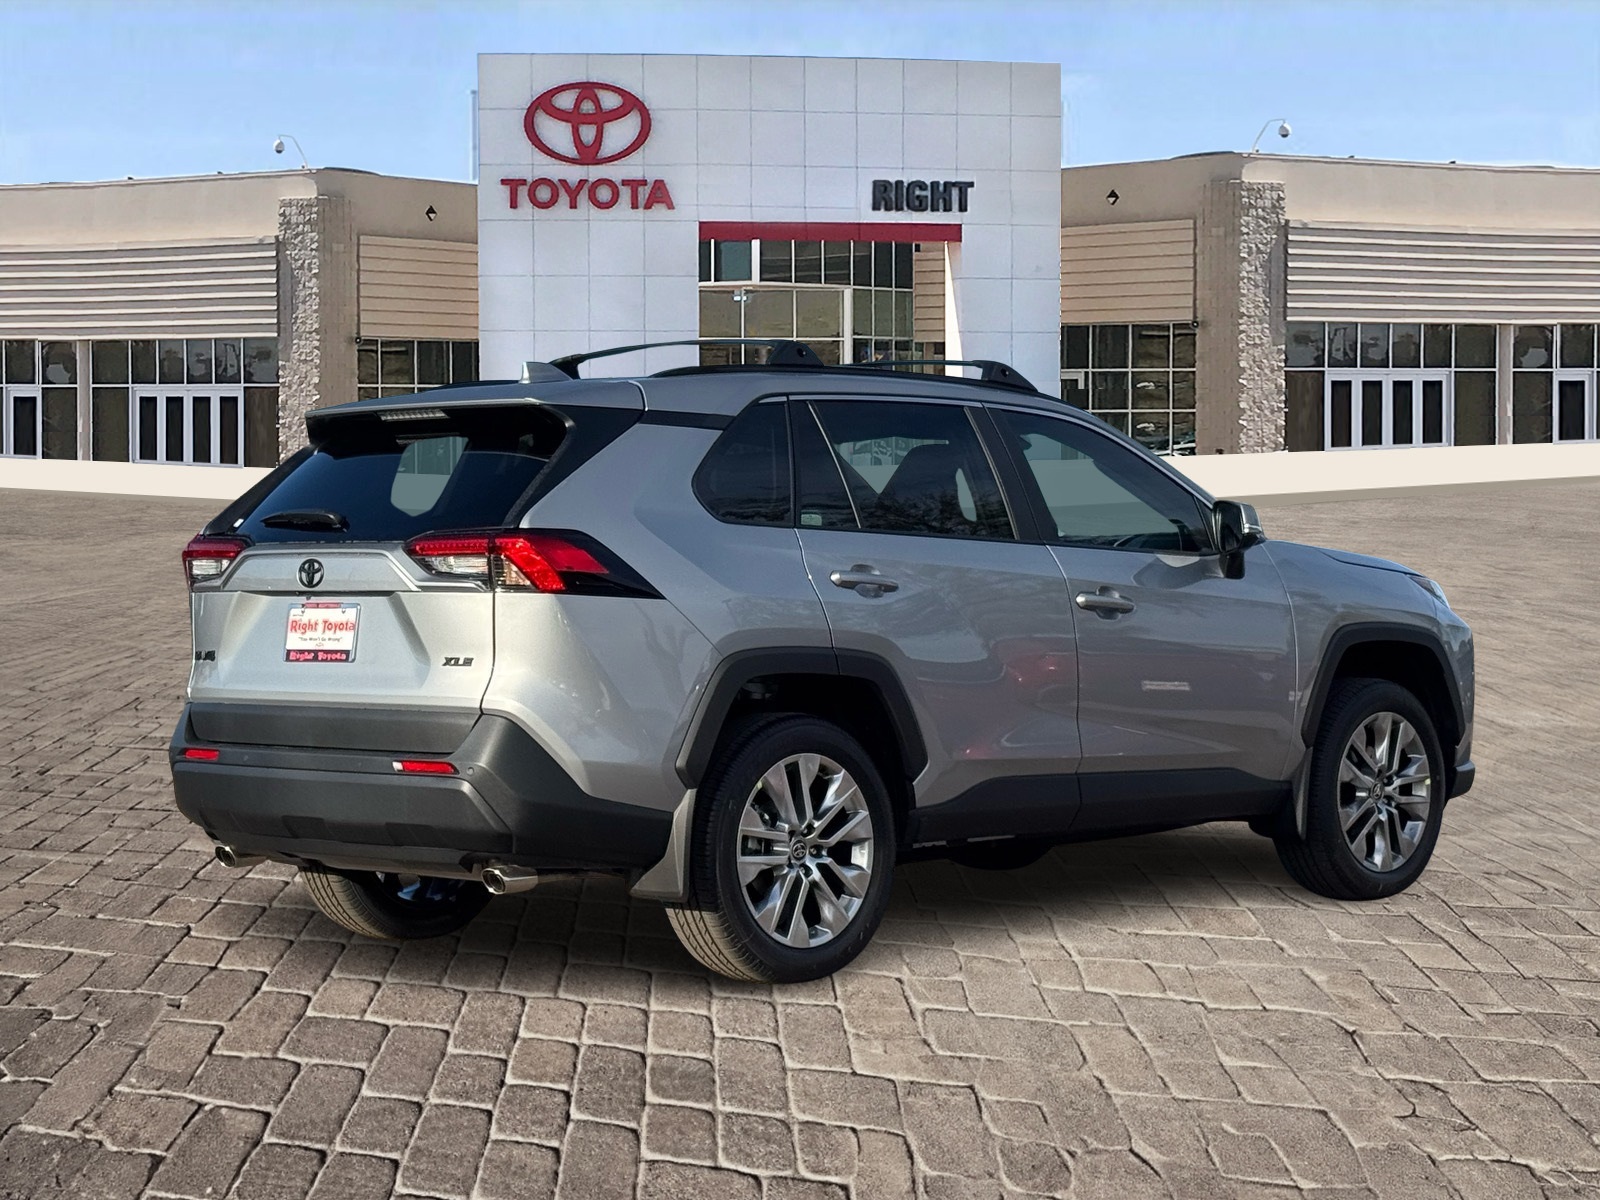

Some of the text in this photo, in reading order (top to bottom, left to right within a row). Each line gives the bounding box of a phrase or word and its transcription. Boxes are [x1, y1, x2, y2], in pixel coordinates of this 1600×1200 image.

[500, 178, 675, 210] TOYOTA
[871, 179, 975, 213] RIGHT
[290, 620, 355, 635] Right Toyota
[442, 657, 474, 666] XLE
